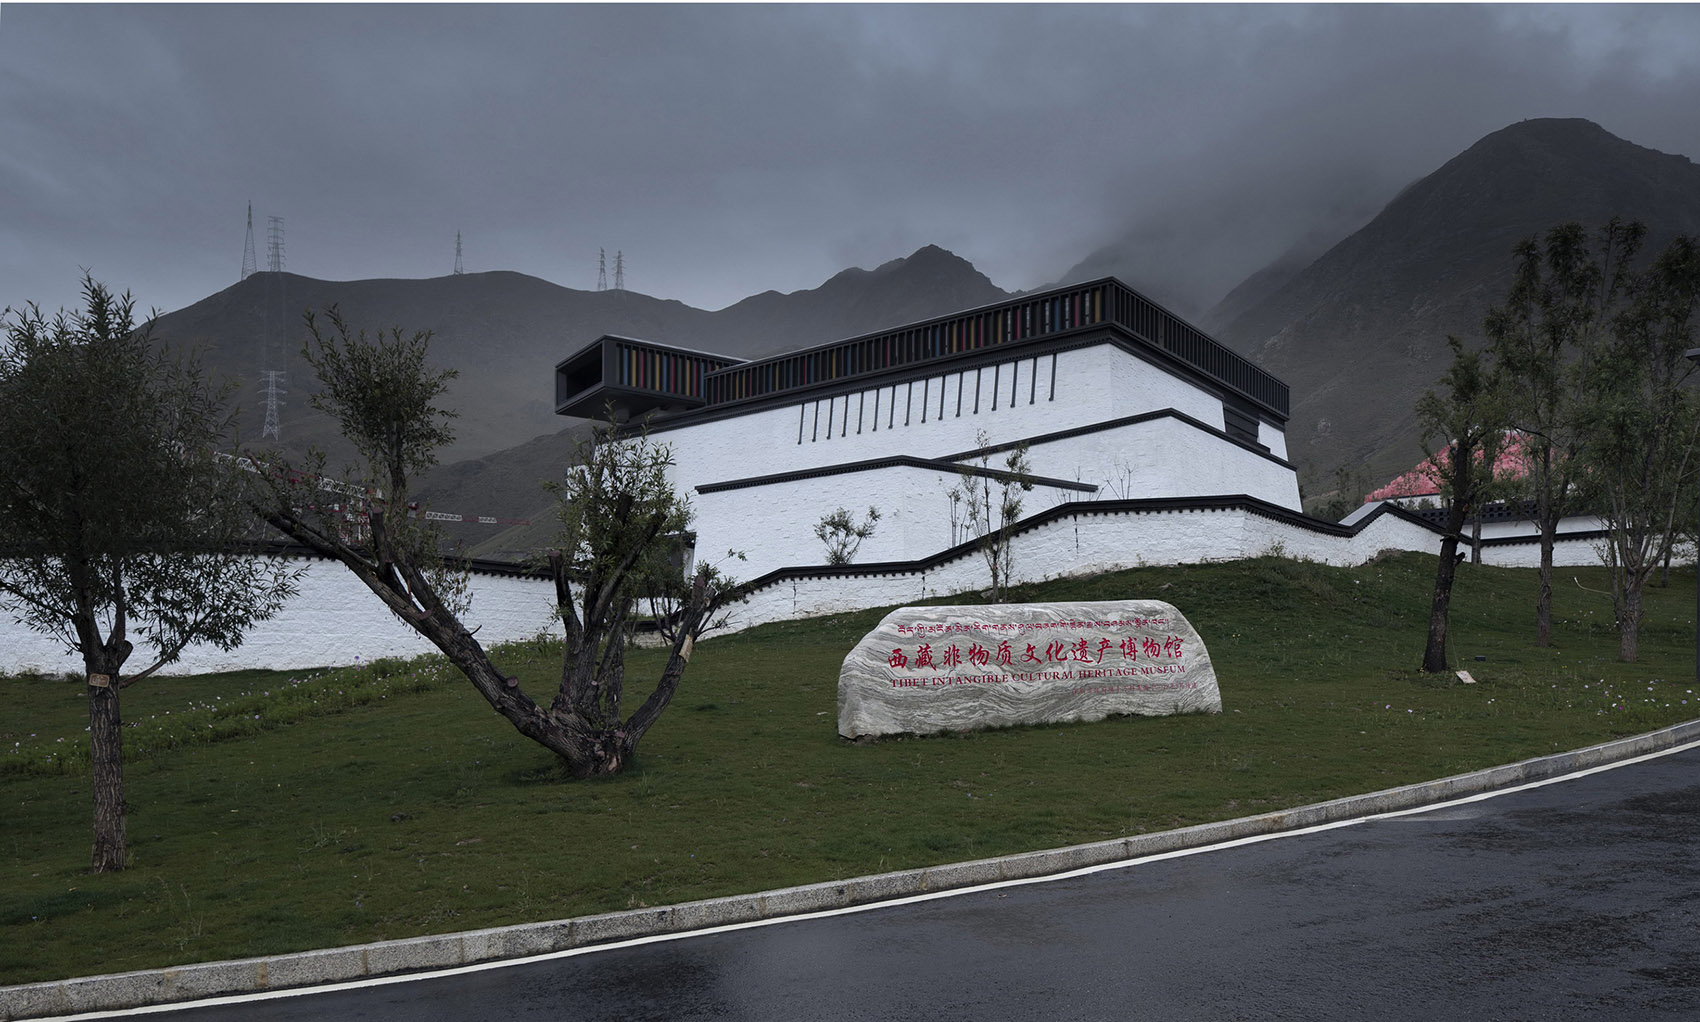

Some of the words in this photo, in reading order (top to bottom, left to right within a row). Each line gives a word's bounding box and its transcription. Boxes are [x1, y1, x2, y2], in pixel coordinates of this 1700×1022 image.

[888, 636, 1184, 671] 西藏非物质文化遗产博物馆
[892, 678, 928, 687] TIBET
[932, 674, 1008, 686] INTANGIBLE
[1012, 671, 1075, 682] CULTURAL
[1078, 667, 1138, 679] HERITAGE
[1140, 665, 1186, 675] MUSEUM
